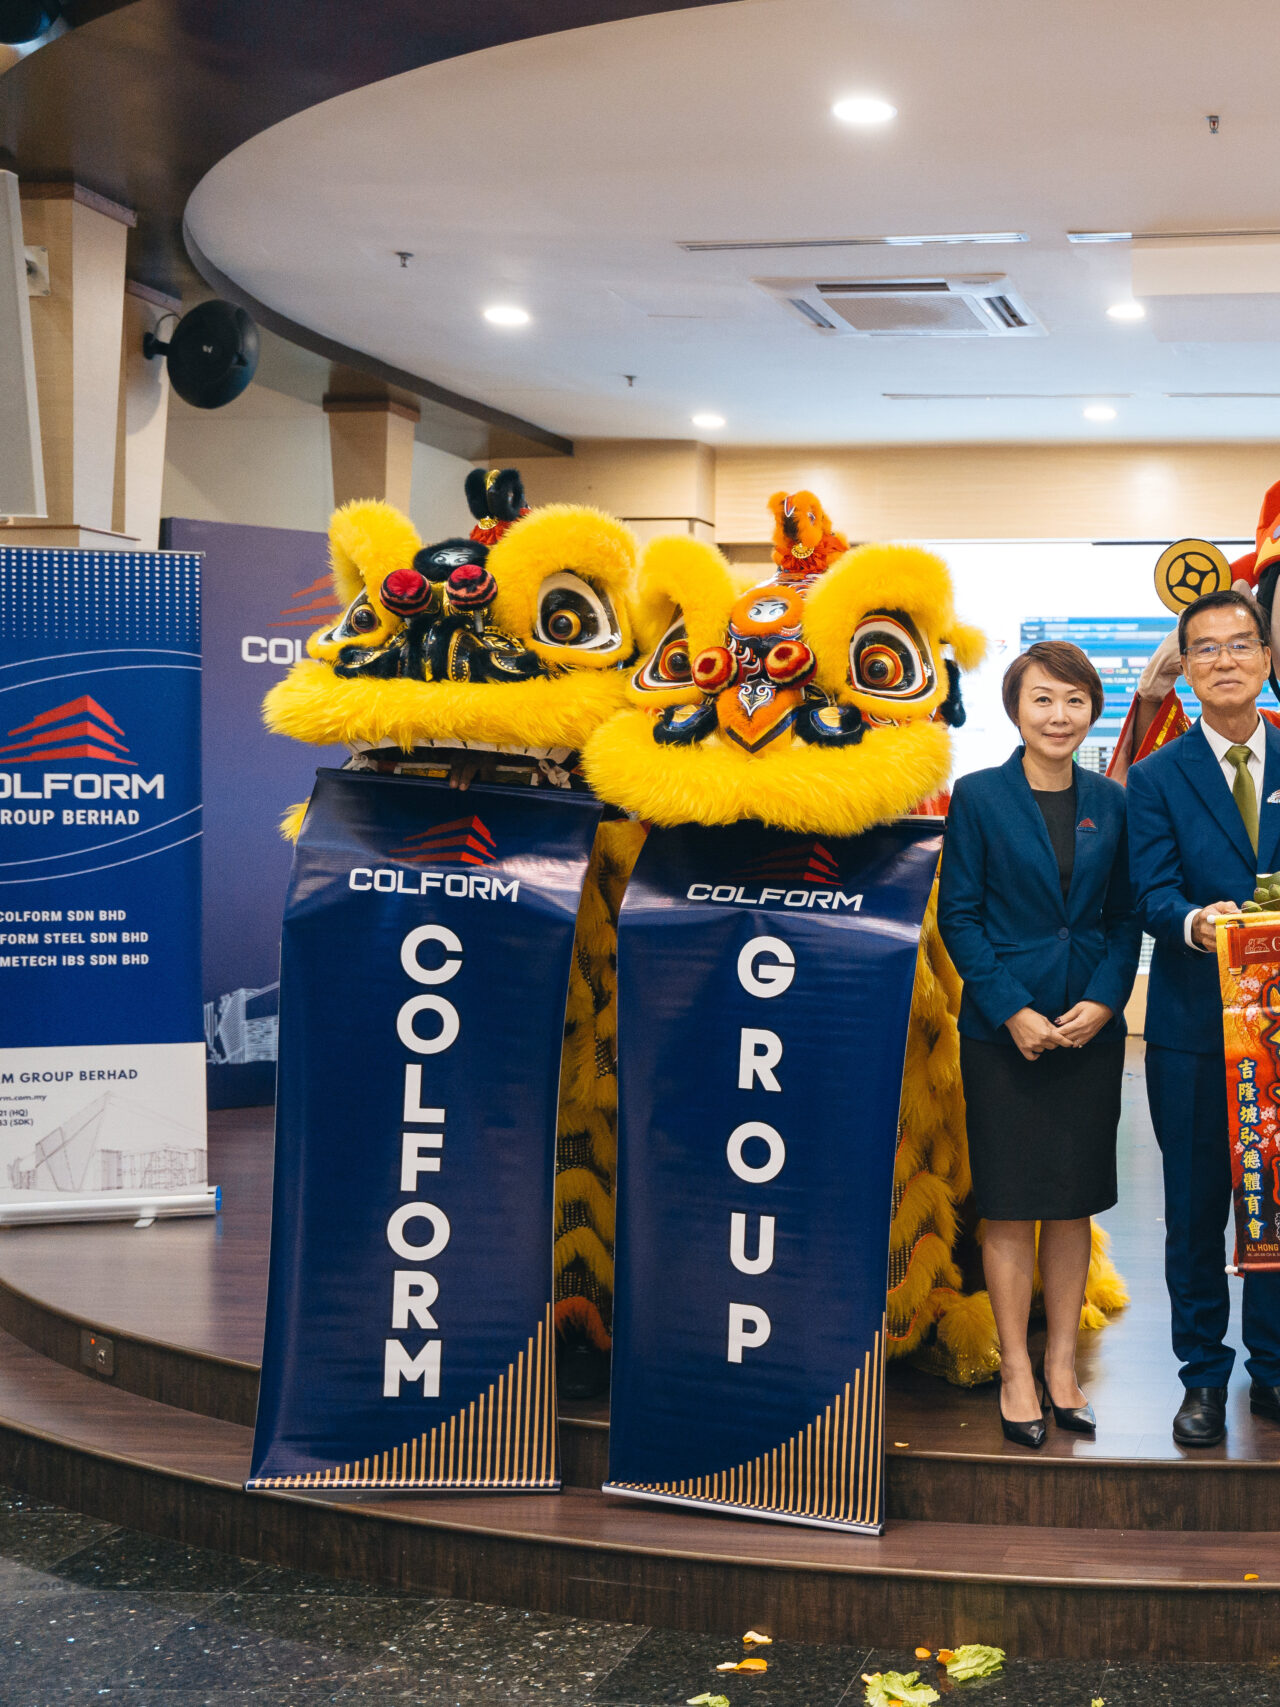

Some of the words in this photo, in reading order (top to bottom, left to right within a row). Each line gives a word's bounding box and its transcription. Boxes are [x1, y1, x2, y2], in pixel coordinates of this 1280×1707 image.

[62, 809, 140, 825] BERHAD
[348, 868, 520, 903] COLFORM
[686, 883, 864, 912] COLFORM
[67, 911, 95, 922] SDN
[99, 910, 127, 921] BHD
[44, 933, 86, 944] STEEL
[90, 932, 118, 944] SDN
[121, 932, 149, 943] BHD
[62, 955, 85, 967] IBS
[90, 955, 118, 966] SDN
[121, 954, 150, 966] BHD
[20, 1071, 74, 1083] GROUP
[79, 1069, 138, 1081] BERHAD
[726, 935, 796, 1364] GROUP
[383, 924, 463, 1398] COLFORM
[1246, 1243, 1256, 1252] KL
[1257, 1243, 1279, 1252] HONG
